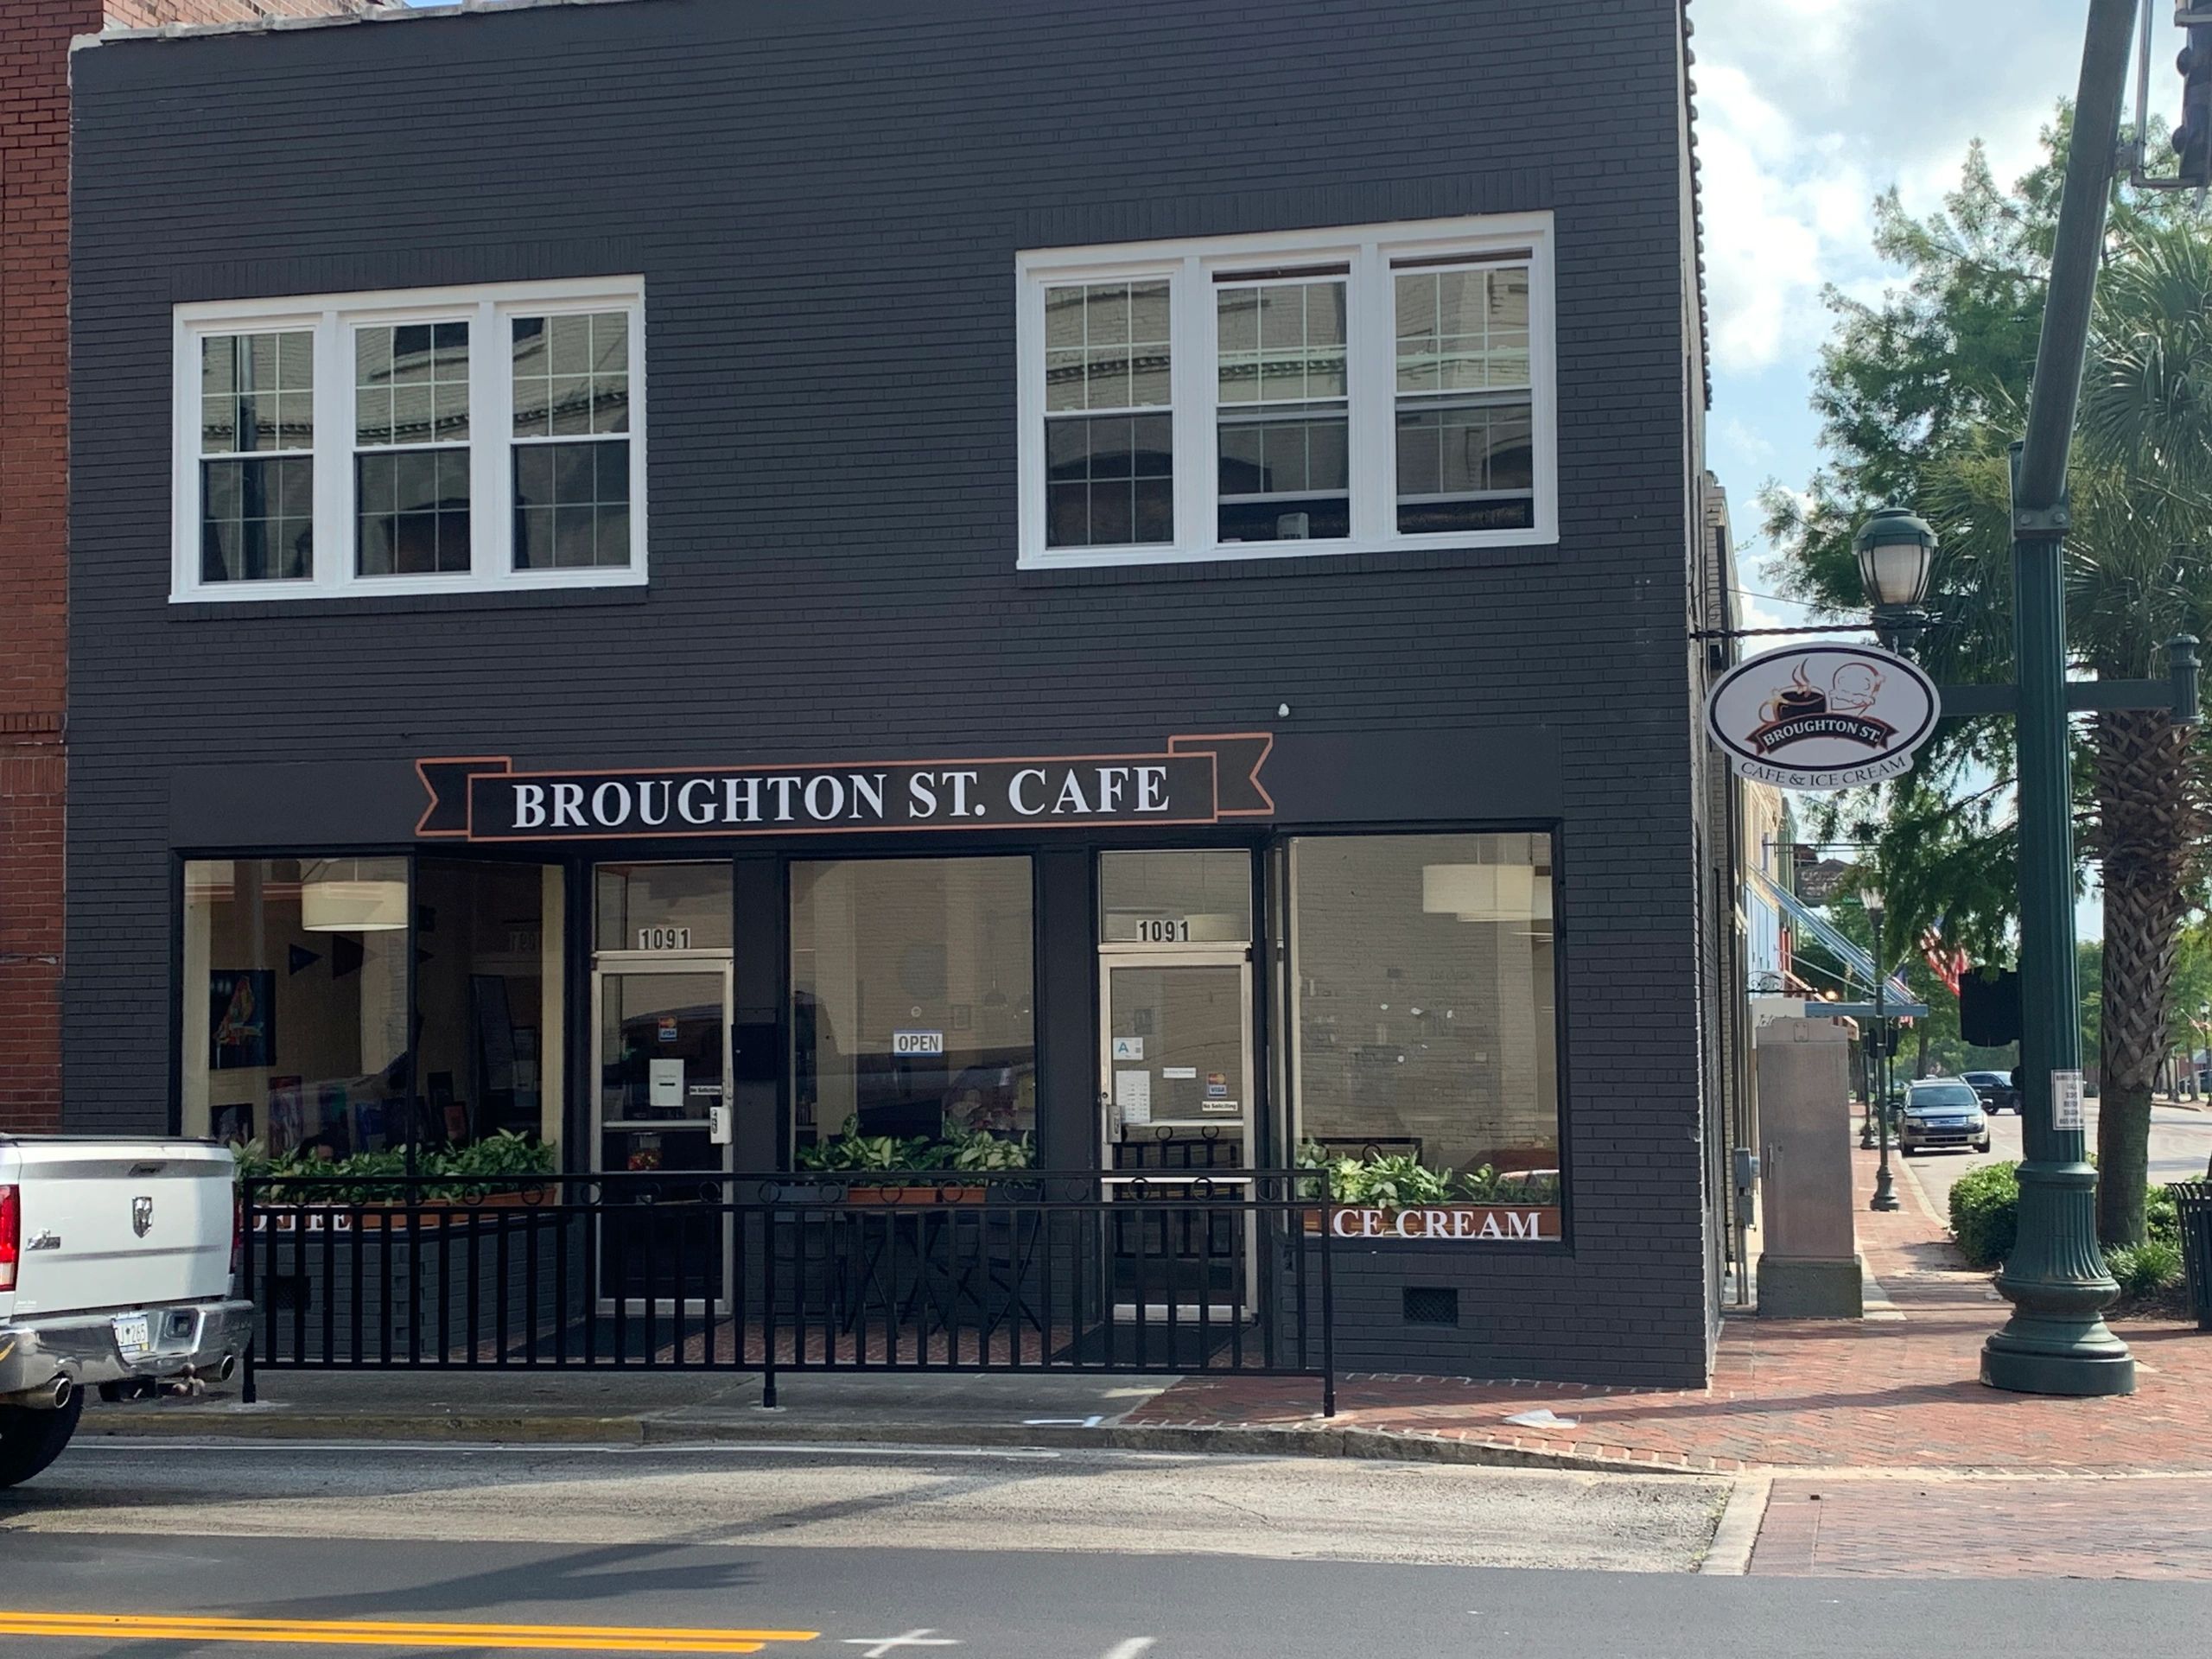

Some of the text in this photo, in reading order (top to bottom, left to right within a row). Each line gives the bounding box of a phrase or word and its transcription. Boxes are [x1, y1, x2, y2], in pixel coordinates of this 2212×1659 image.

[1762, 720, 1880, 747] BROUGHTON ST.
[1741, 755, 1907, 786] CAFE & ICE CREAM
[512, 766, 1170, 829] BROUGHTON ST. CAFE
[642, 928, 689, 950] 1091
[1139, 920, 1189, 943] 1091
[899, 1035, 939, 1052] OPEN
[1118, 1041, 1129, 1053] A
[1318, 1208, 1541, 1241] CE CREAM
